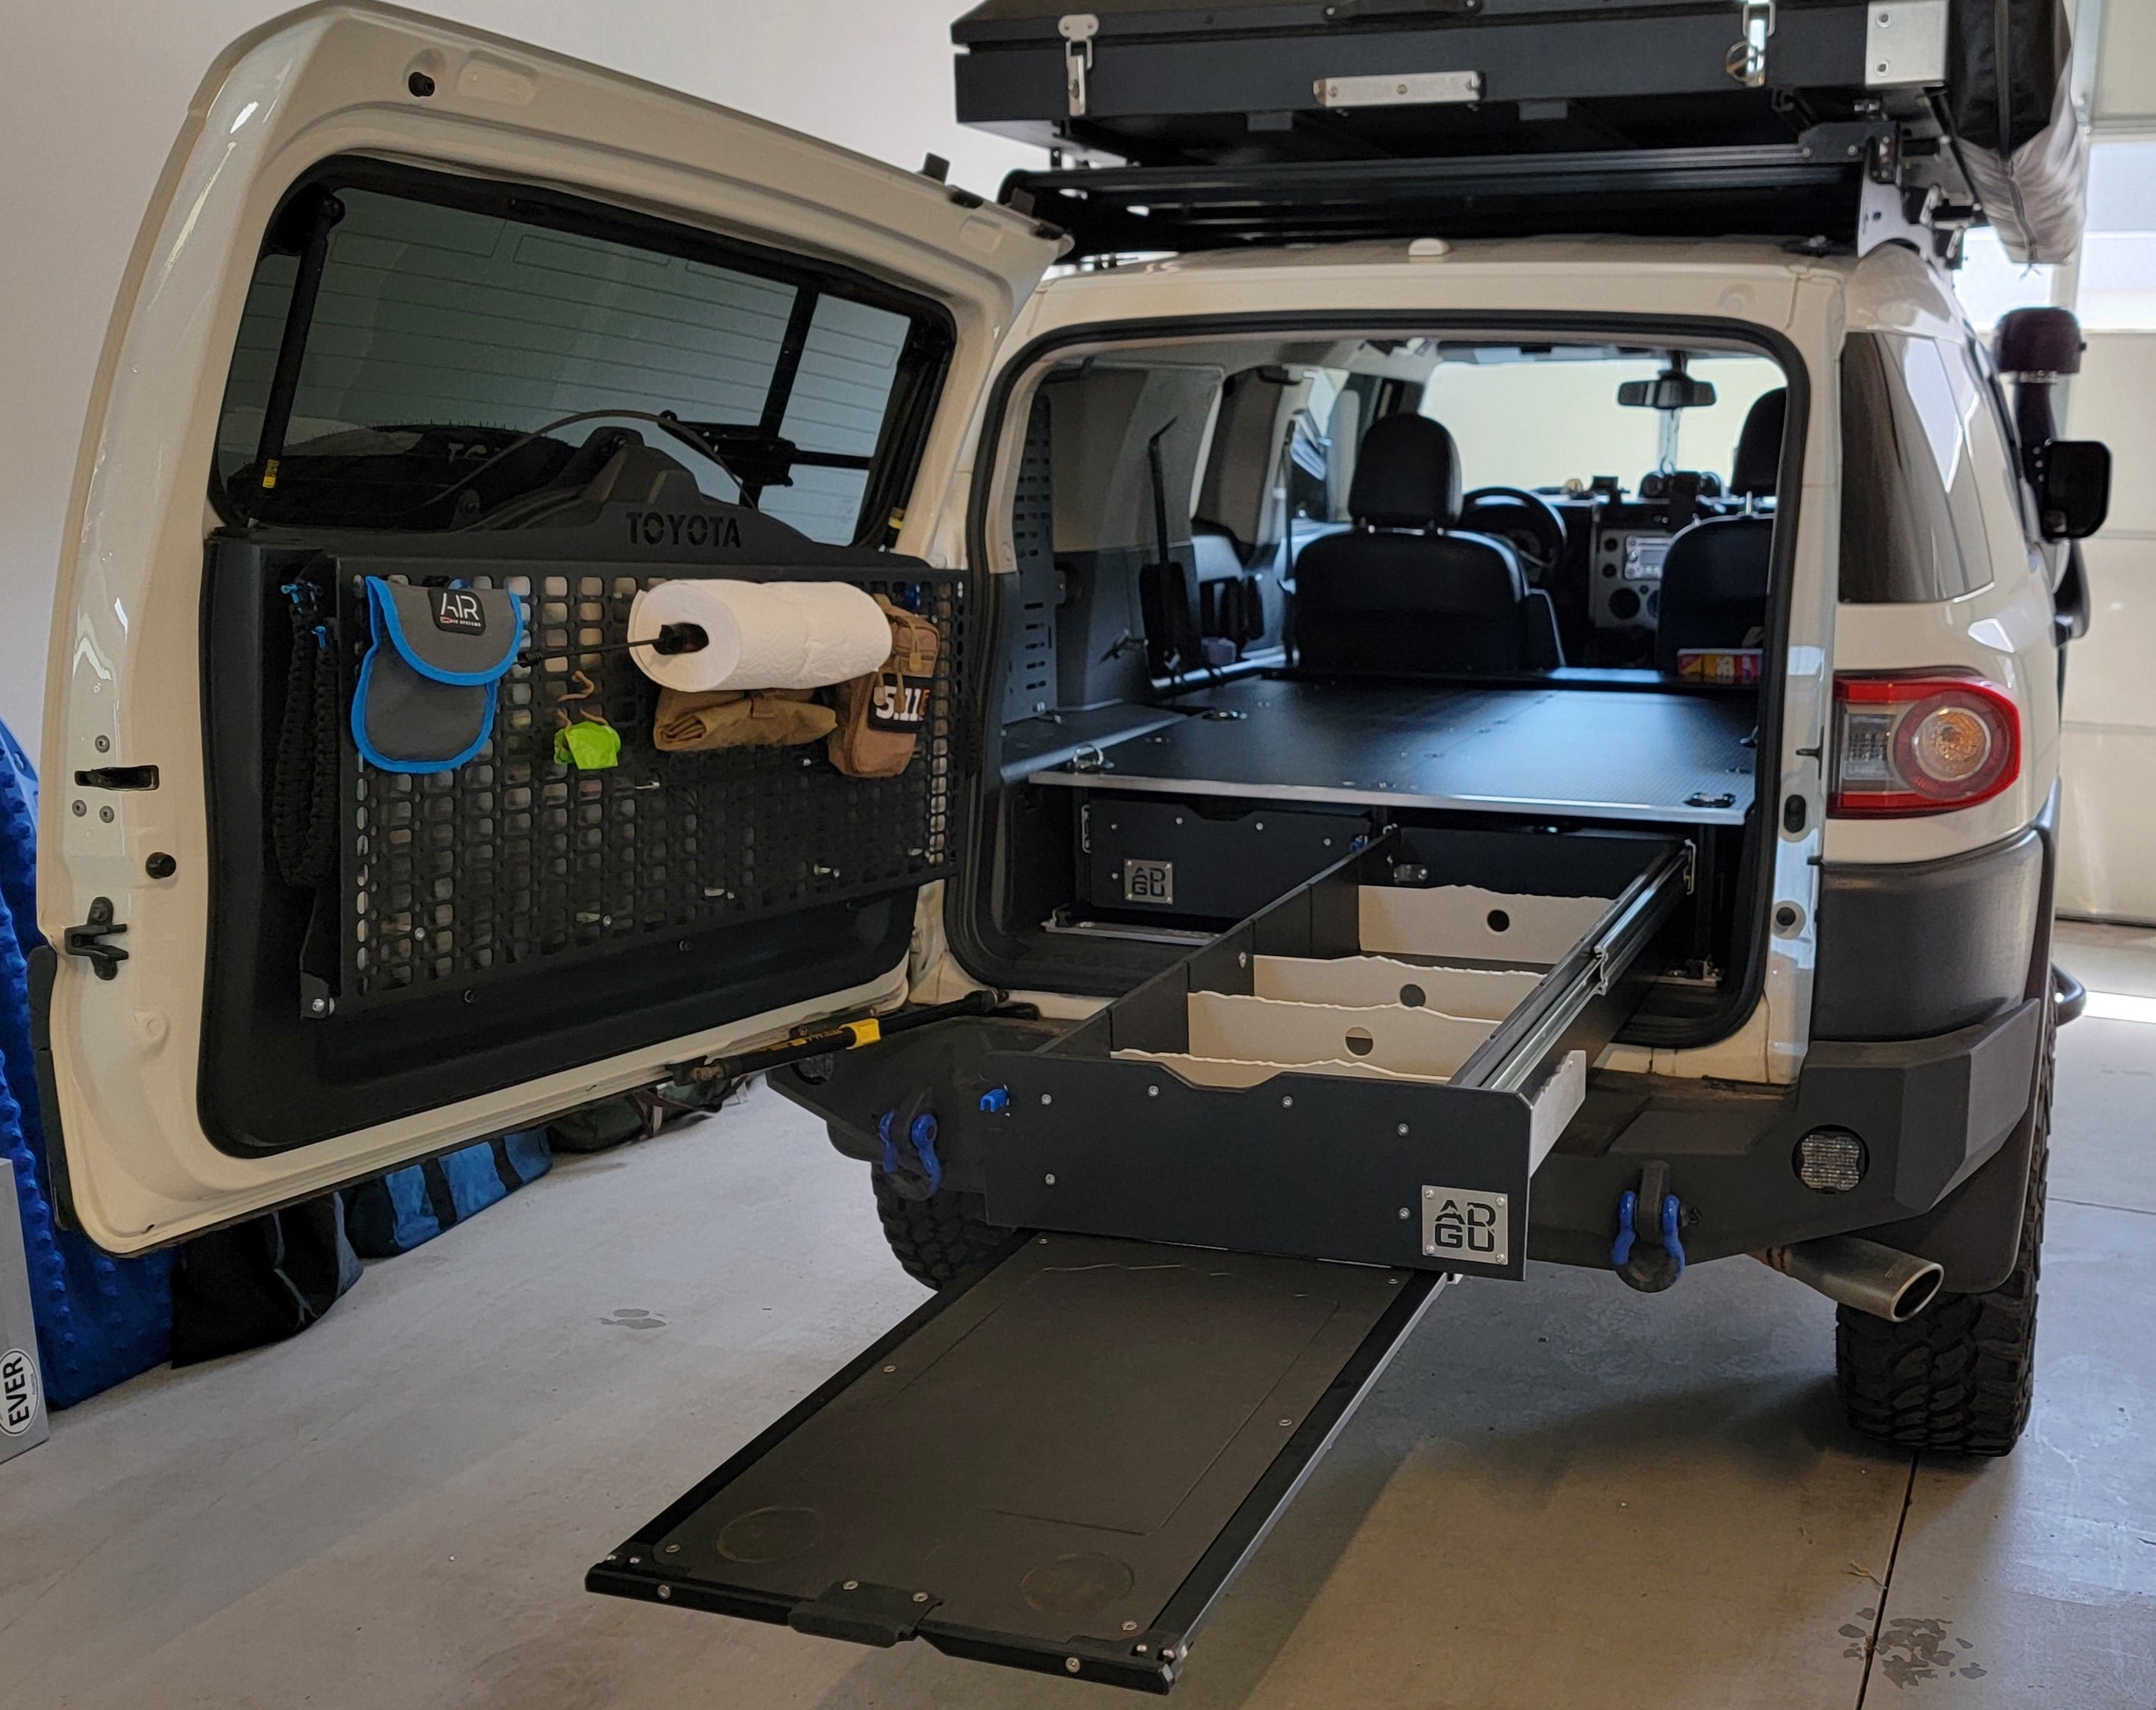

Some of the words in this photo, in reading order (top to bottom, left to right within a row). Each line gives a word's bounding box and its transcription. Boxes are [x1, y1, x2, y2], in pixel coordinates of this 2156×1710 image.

[626, 511, 742, 548] TOYOTA
[440, 593, 480, 620] AIR
[2, 1356, 30, 1426] EVER
